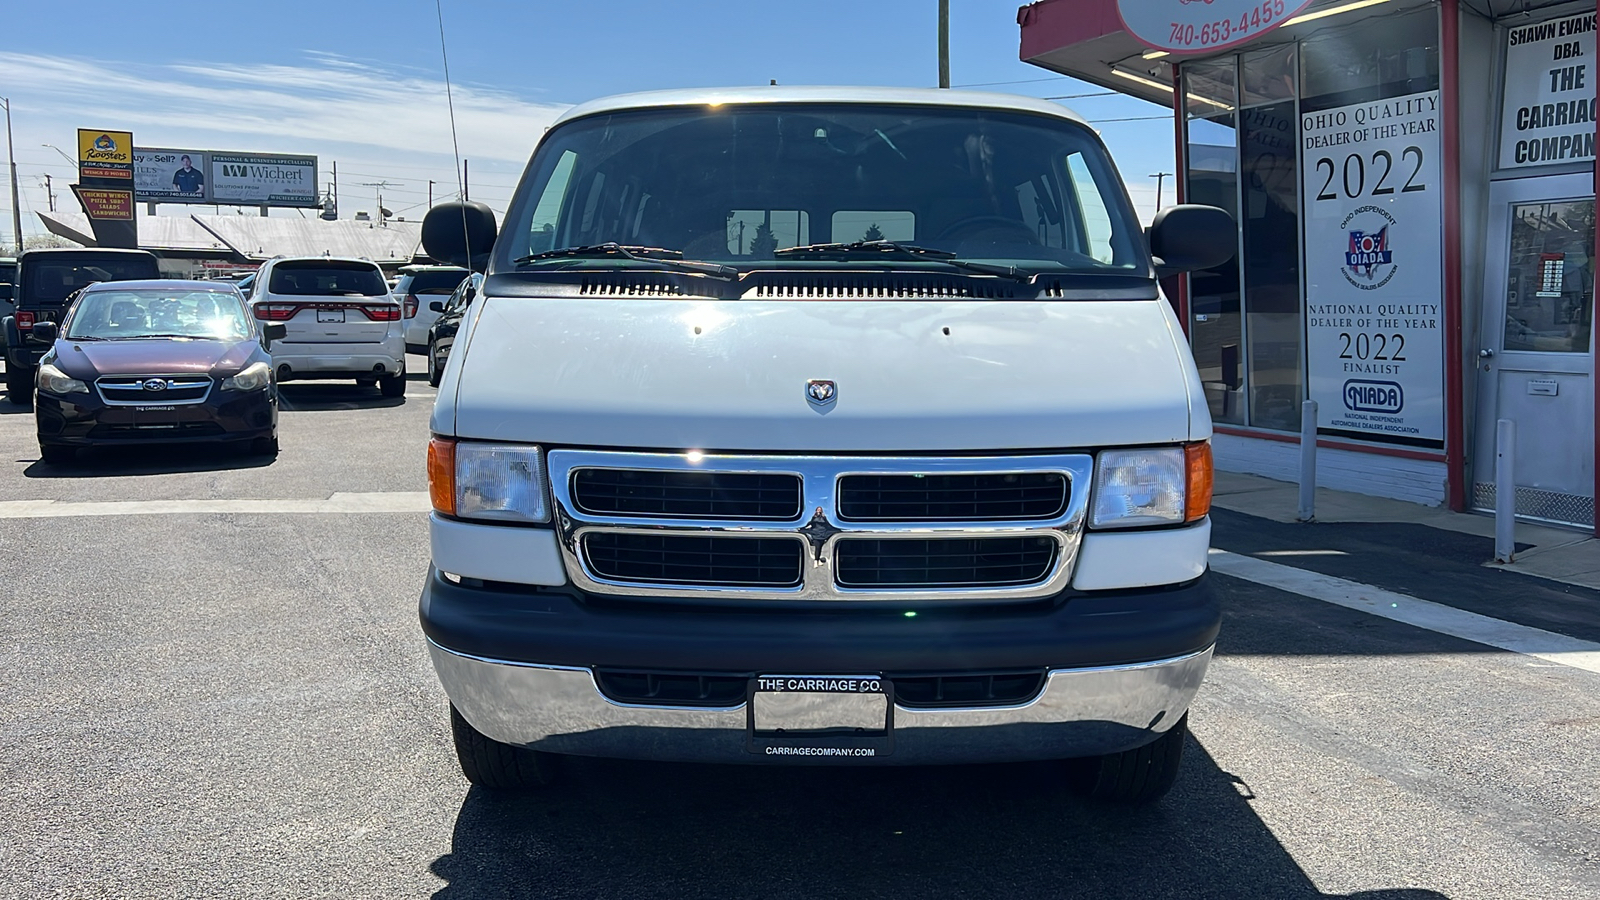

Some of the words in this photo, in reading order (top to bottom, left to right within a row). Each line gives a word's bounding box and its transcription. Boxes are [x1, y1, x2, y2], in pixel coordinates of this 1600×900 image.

[1169, 0, 1284, 45] 740-653-4455
[1510, 22, 1556, 46] SHAWN
[1558, 14, 1597, 37] EVANS
[1553, 41, 1583, 60] DBA.
[1550, 65, 1585, 93] THE
[1303, 111, 1347, 131] OHIO
[1354, 95, 1438, 125] QUALITY
[1516, 97, 1597, 131] CARRIA
[1306, 131, 1351, 150] DEALER
[1353, 128, 1369, 143] OF
[1372, 124, 1398, 140] THE
[1401, 118, 1436, 136] YEAR
[85, 148, 127, 161] Roosters
[1515, 132, 1597, 164] COMPAN
[133, 155, 144, 163] uy
[154, 155, 175, 163] Sell?
[250, 165, 303, 180] Wichert
[1316, 145, 1426, 201] 2022
[1340, 212, 1355, 230] OHIO
[1354, 205, 1397, 226] INDEPENDENT
[1351, 252, 1384, 265] OIADA
[1309, 304, 1372, 315] NATIONAL
[1378, 304, 1438, 316] QUALITY
[1310, 318, 1352, 328] DEALER
[1357, 318, 1371, 328] OF
[1376, 319, 1399, 328] THE
[1404, 319, 1436, 329] YEAR
[1339, 332, 1406, 361] 2022
[1343, 362, 1400, 374] FINALIST
[1347, 386, 1398, 407] NIADA
[1331, 420, 1361, 429] AUTOMOBILE
[1362, 422, 1383, 431] DEALERS
[1384, 424, 1420, 434] ASSOCIATION
[1344, 412, 1368, 421] NATIONAL
[1370, 414, 1404, 424] INDEPENDENT
[758, 679, 785, 690] THE
[787, 679, 857, 691] CARRIAGE
[859, 680, 883, 691] CO.
[765, 746, 875, 757] CARRIAGECOMPANY.COM
